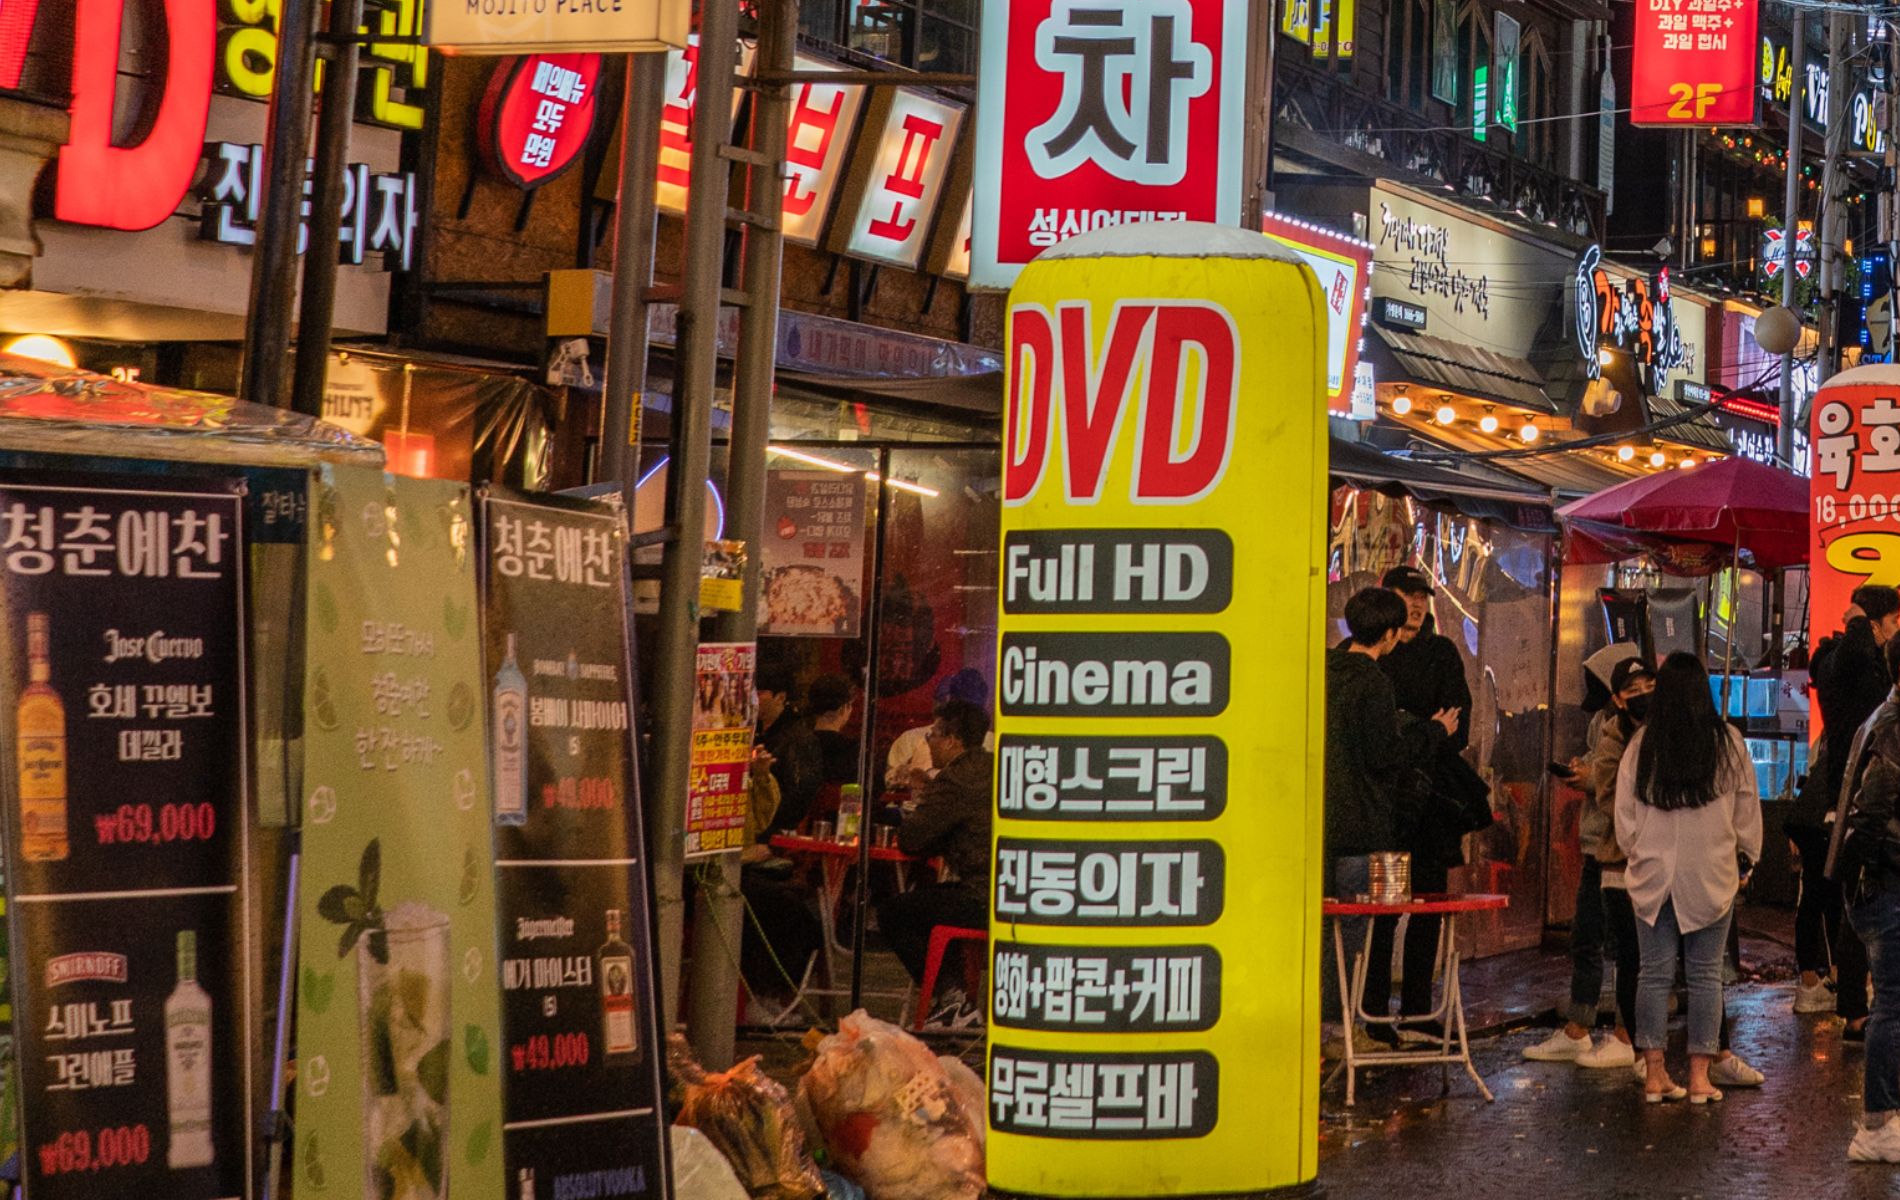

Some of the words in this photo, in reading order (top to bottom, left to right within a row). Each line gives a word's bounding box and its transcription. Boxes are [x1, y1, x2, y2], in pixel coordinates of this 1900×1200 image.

[1657, 15, 1689, 32] 과일
[1662, 34, 1692, 52] 과일
[1696, 34, 1729, 52] 접시
[532, 99, 566, 134] 모두
[1667, 83, 1724, 119] 2F
[520, 133, 556, 167] 만원
[1004, 301, 1238, 507] DVD
[1, 502, 229, 579] 청춘예찬
[494, 514, 614, 588] 청춘예찬
[1007, 543, 1095, 603] Full
[1113, 543, 1209, 602] HD
[104, 629, 145, 664] Jose
[144, 629, 204, 664] Cuervo
[88, 682, 137, 719] 호세
[1002, 645, 1213, 706] Cinema
[1000, 746, 1207, 811] 대형스크린
[997, 849, 1204, 919] 진동의자
[993, 951, 1202, 1026] 영화+팝콘+커피
[44, 999, 136, 1042] 스미노프
[46, 1048, 137, 1092] 그린애플
[991, 1056, 1199, 1129] 무료셀프바
